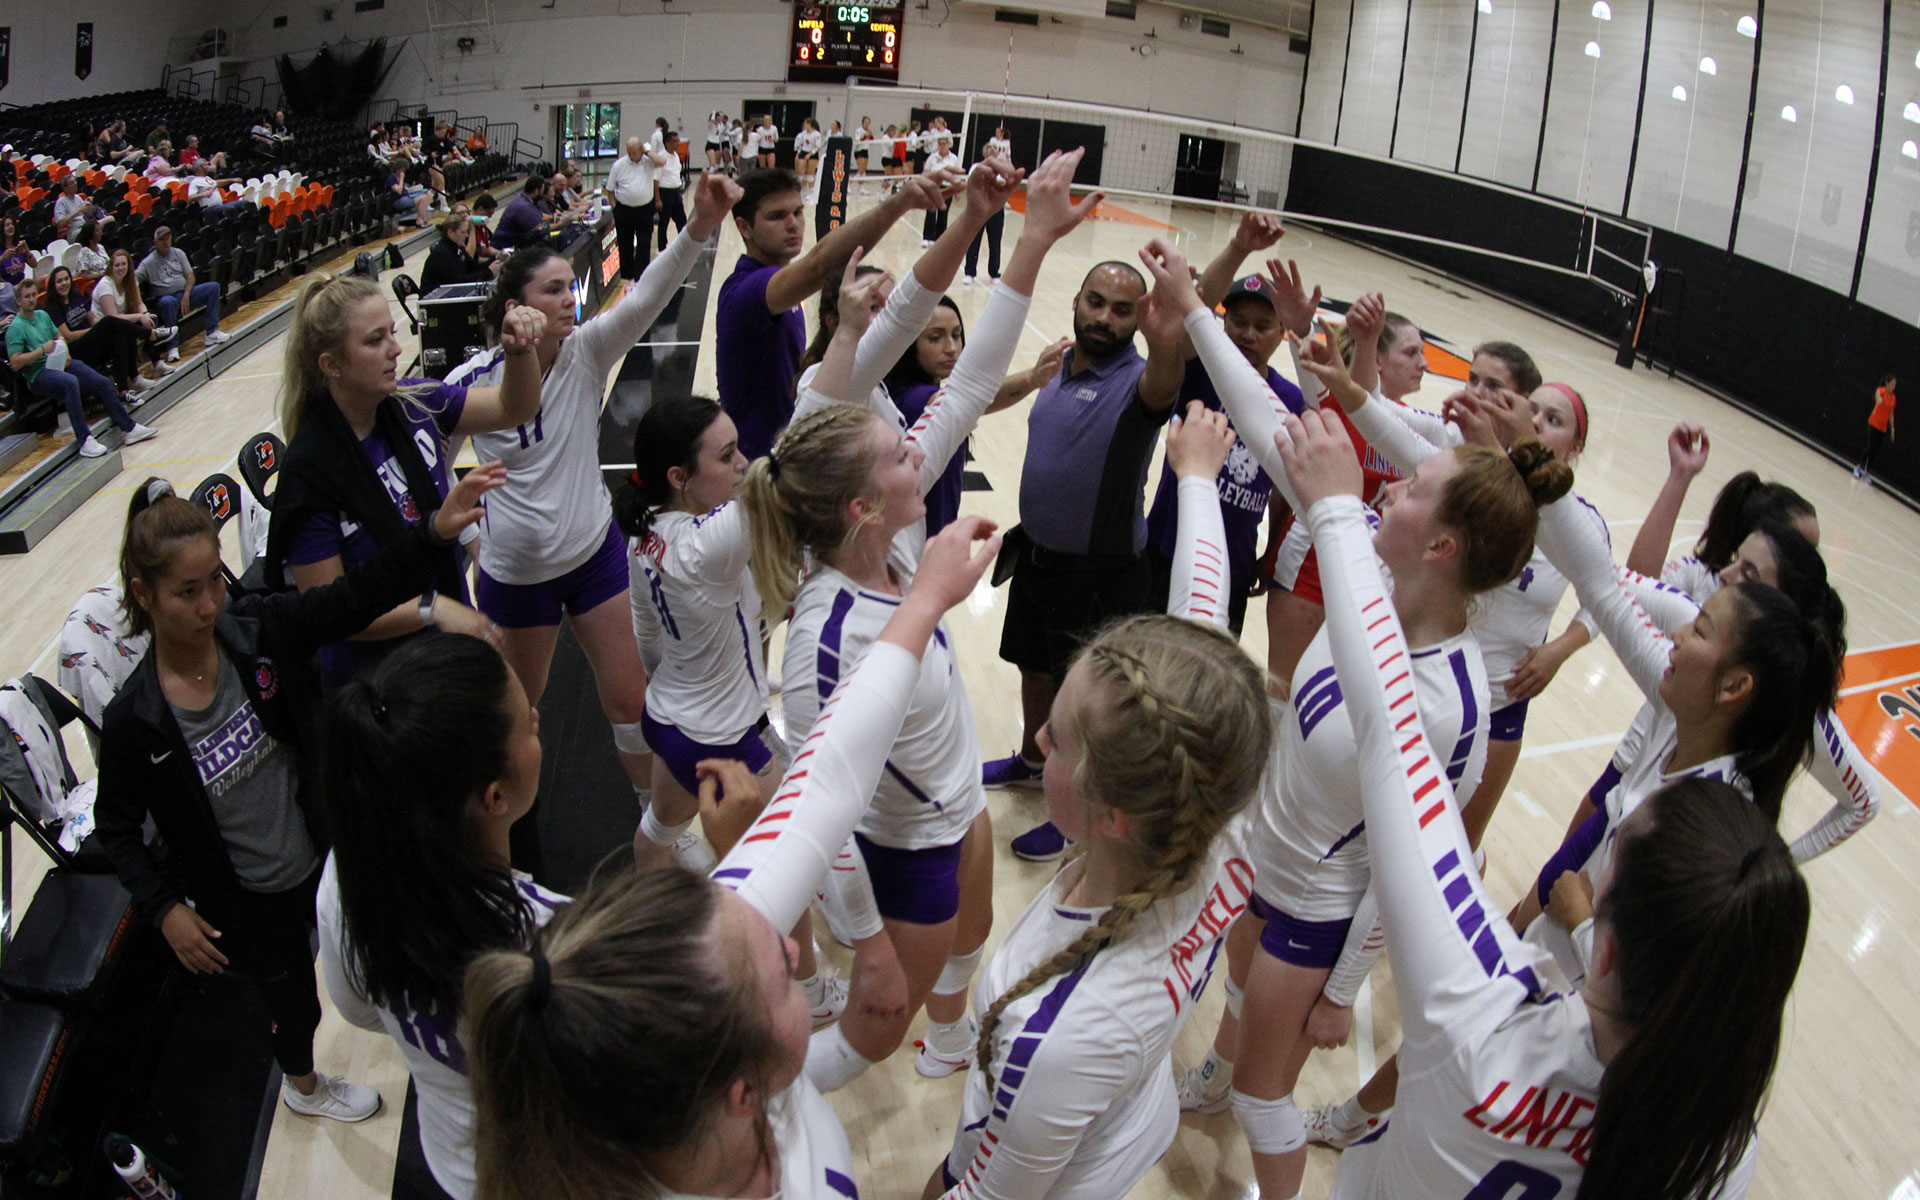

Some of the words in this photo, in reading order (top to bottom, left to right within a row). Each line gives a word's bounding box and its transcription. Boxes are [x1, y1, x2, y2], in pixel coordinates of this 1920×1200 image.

[838, 6, 869, 22] 0:05
[811, 28, 822, 43] 0
[885, 32, 895, 47] 0
[800, 47, 809, 59] 0
[816, 47, 825, 60] 2
[884, 50, 893, 63] 0
[832, 149, 845, 202] LEWIS
